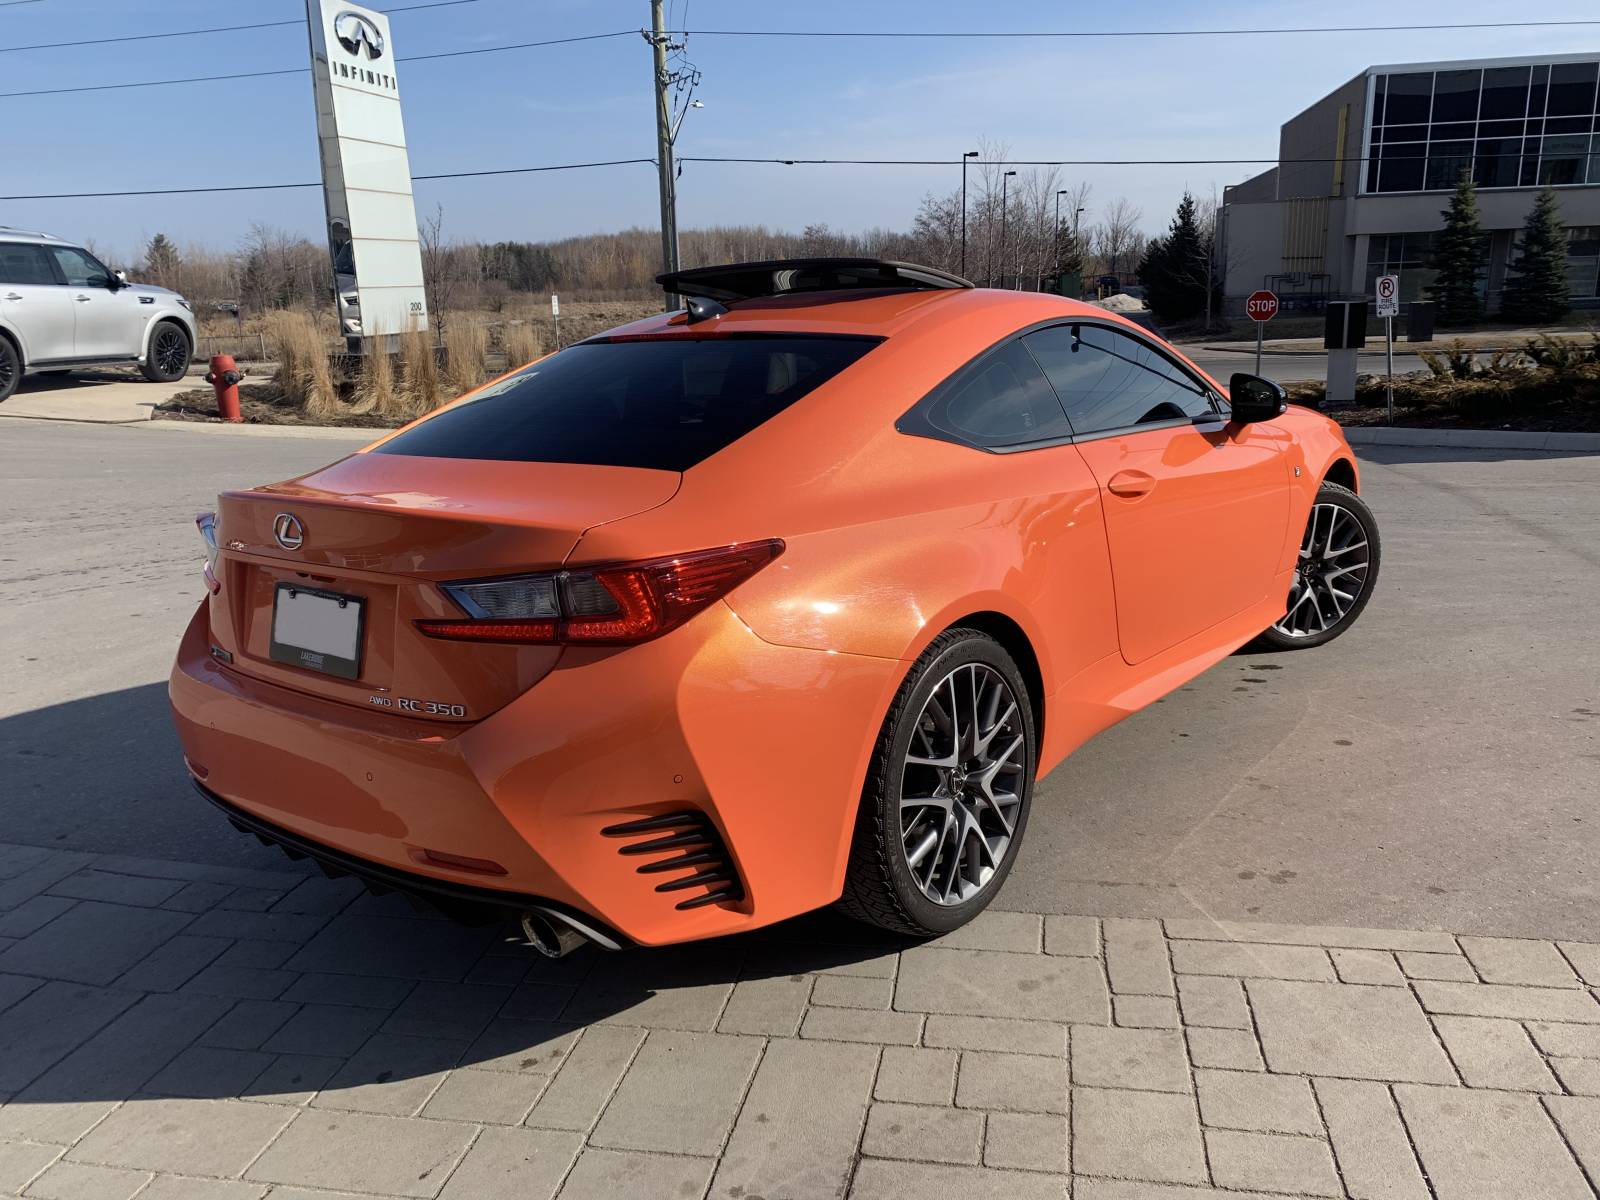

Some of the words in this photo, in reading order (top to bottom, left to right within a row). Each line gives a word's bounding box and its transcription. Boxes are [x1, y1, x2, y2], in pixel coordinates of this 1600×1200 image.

[332, 61, 396, 90] INFINITI
[410, 302, 422, 311] 200
[1249, 300, 1276, 312] STOP
[1379, 302, 1397, 310] ROUTE
[369, 695, 392, 707] AWD
[398, 697, 422, 712] RC
[425, 702, 465, 717] 350
